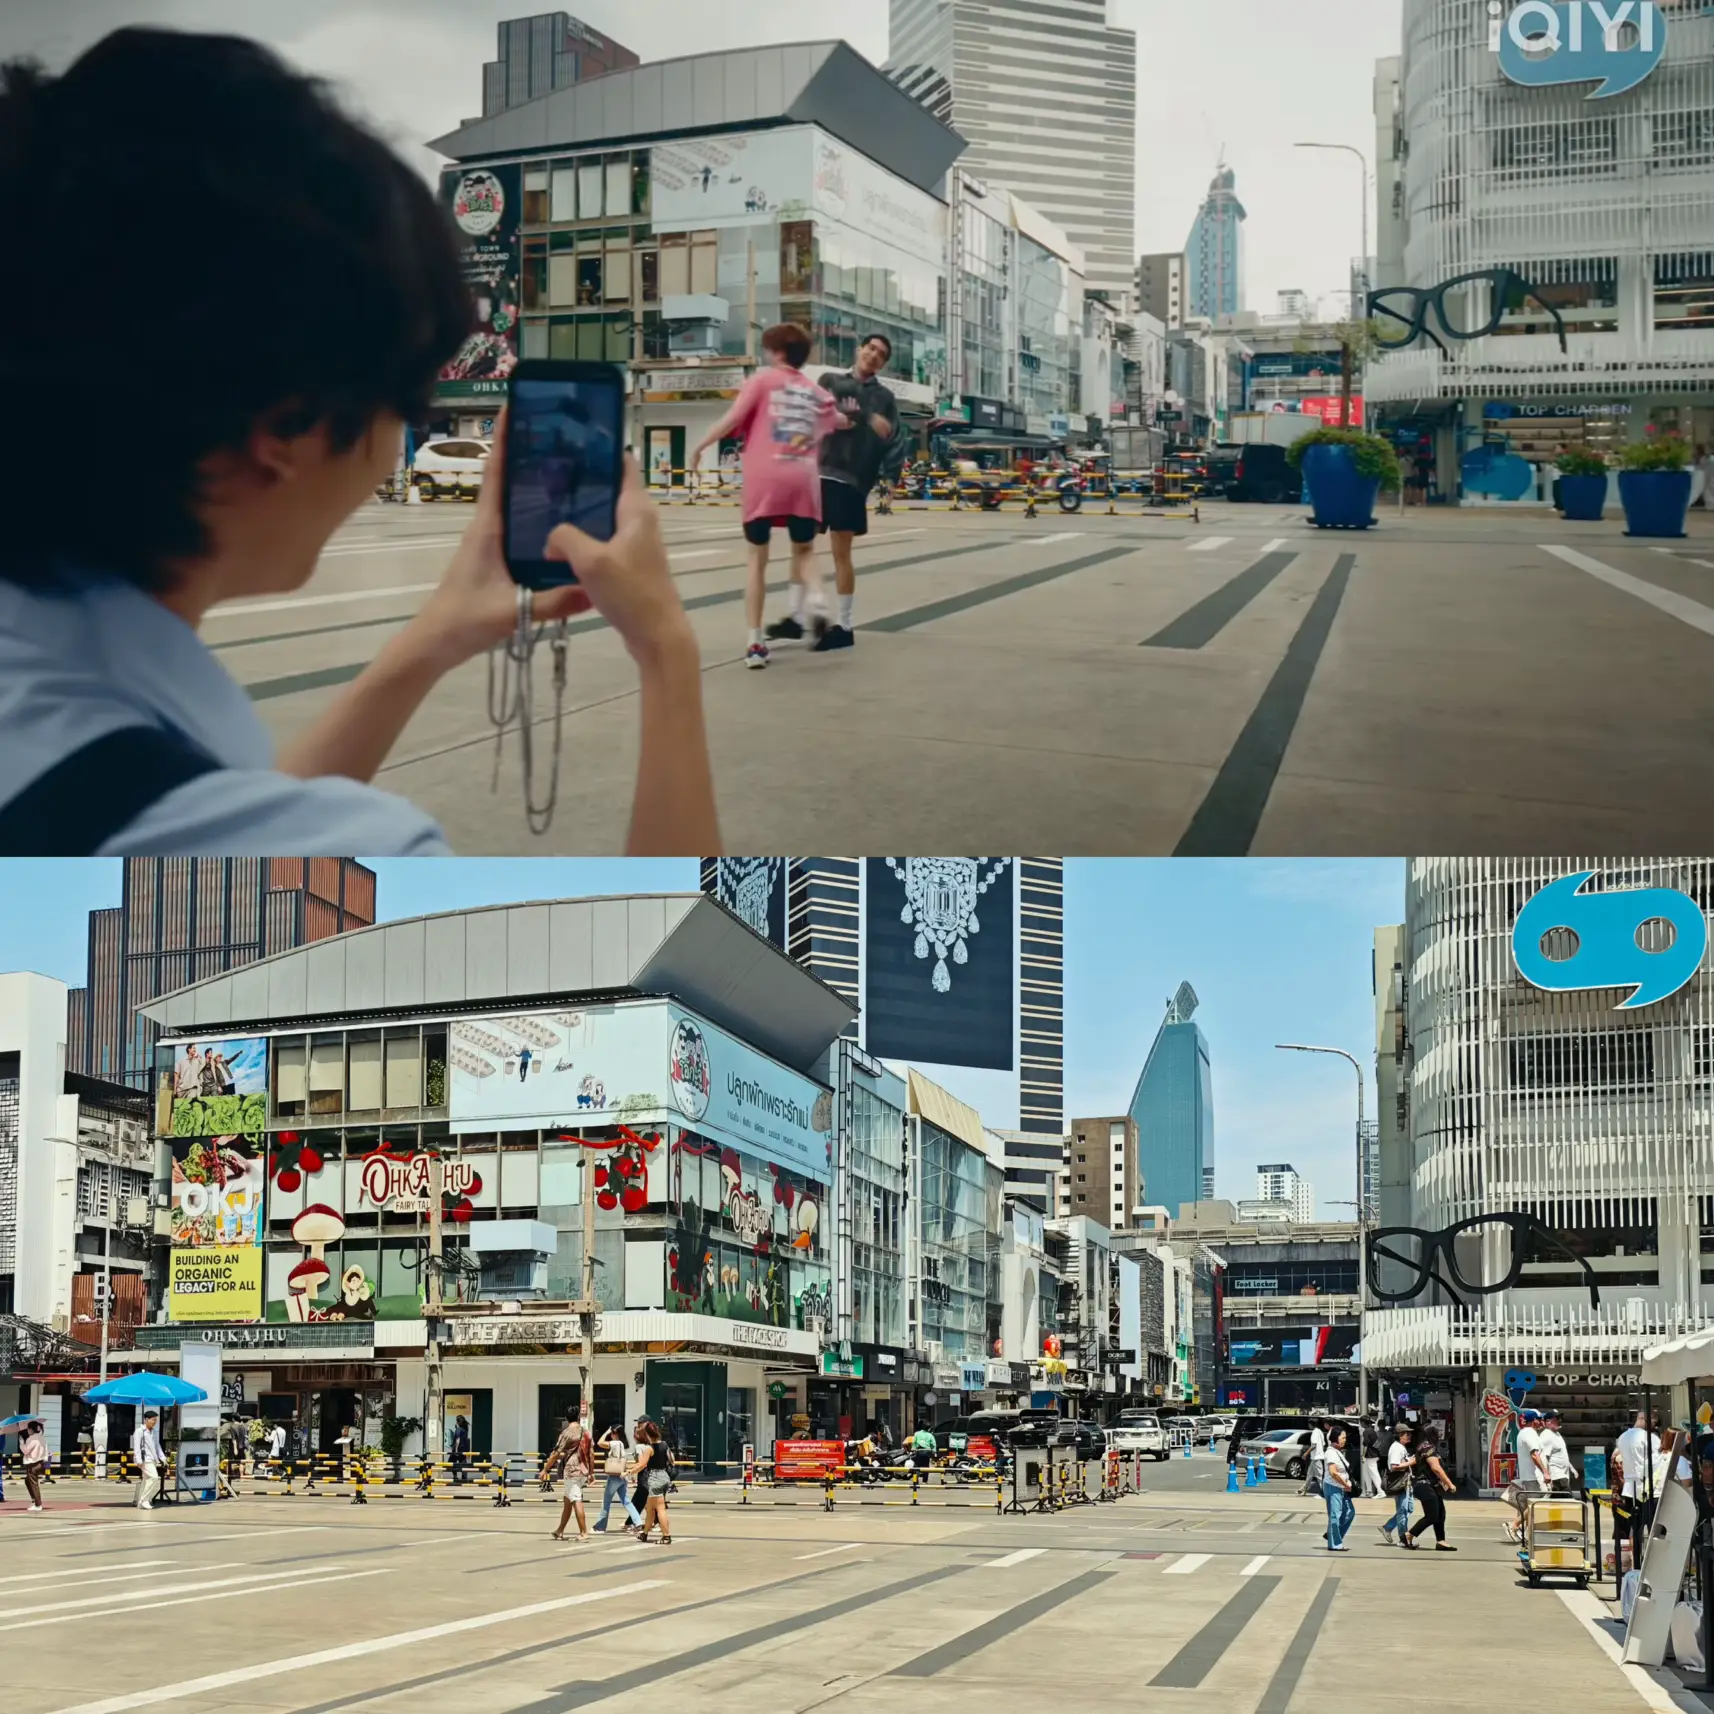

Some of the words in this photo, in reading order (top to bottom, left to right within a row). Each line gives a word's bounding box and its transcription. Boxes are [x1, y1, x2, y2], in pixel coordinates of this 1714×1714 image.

[472, 382, 508, 392] OHKA
[1518, 404, 1548, 416] TOP
[727, 1070, 809, 1131] ปลูกผักเพราะรักแม่
[361, 1158, 471, 1202] OHKAHU
[180, 1181, 255, 1217] OKJ
[395, 1200, 416, 1211] FAIRY
[418, 1199, 431, 1210] TAL
[175, 1255, 222, 1266] BUILDING
[223, 1254, 239, 1264] AN
[175, 1268, 232, 1280] ORGANIC
[174, 1282, 214, 1293] LEGACY
[216, 1282, 236, 1292] FOR
[238, 1281, 256, 1291] ALL
[202, 1328, 286, 1342] OHKAJHU
[458, 1322, 494, 1341] THE
[499, 1321, 547, 1340] FACE
[1544, 1374, 1579, 1386] TOP
[221, 1374, 244, 1401] กะจู๋
